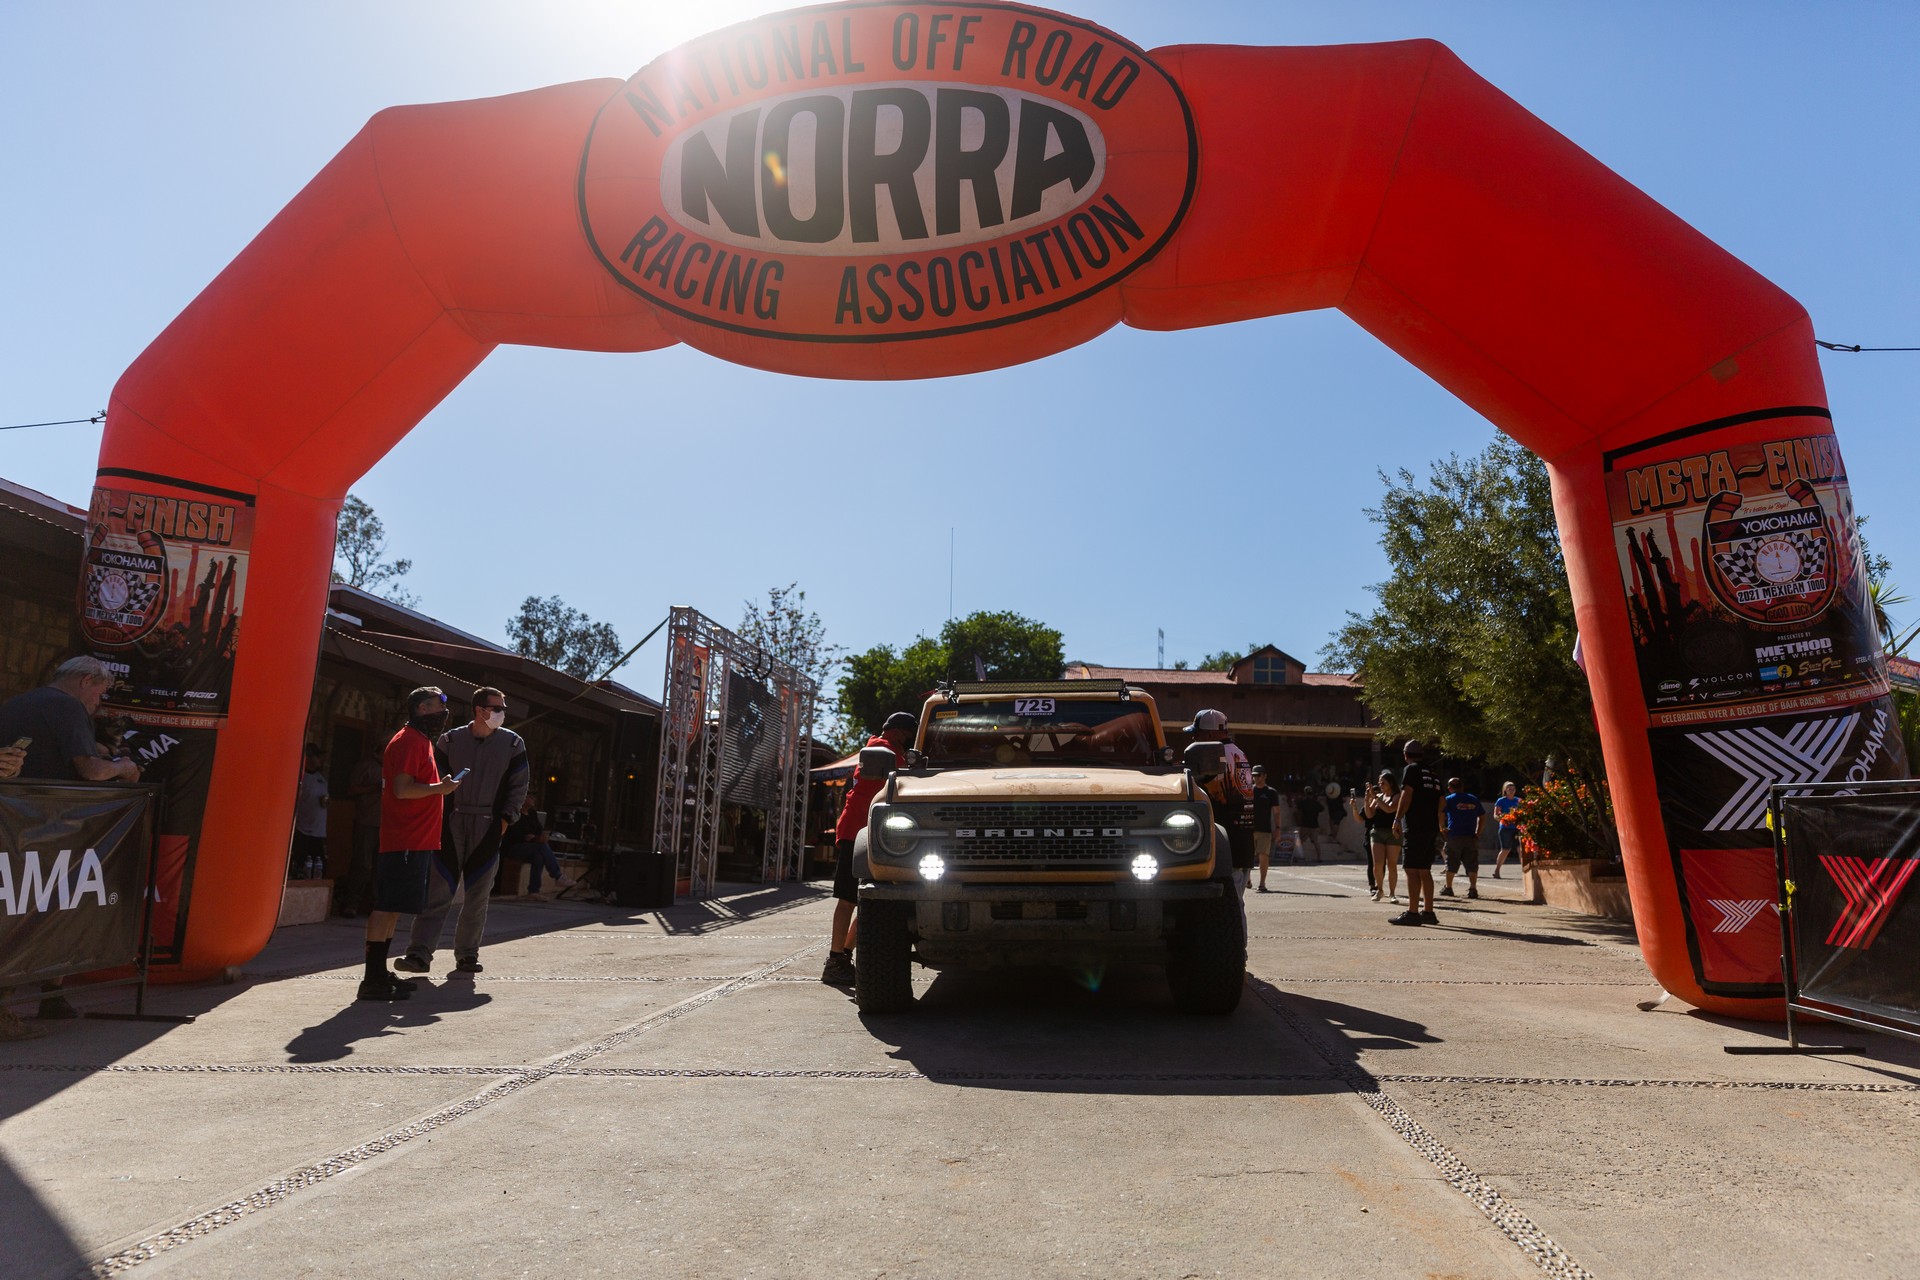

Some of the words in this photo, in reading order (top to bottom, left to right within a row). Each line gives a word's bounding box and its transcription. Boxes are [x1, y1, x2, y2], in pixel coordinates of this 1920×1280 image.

[624, 16, 866, 138] NATIONAL
[891, 13, 983, 72] OFF
[1001, 20, 1141, 111] ROAD
[680, 86, 1096, 244] NORRA
[620, 215, 786, 321] RACING
[834, 193, 1146, 325] ASSOCIATION
[1626, 451, 1739, 512] META
[127, 493, 235, 545] FINISH
[1741, 512, 1818, 534] YOKOHAMA
[1761, 542, 1790, 557] NORRA
[101, 552, 157, 571] YOKOHAMA
[1737, 591, 1760, 603] 2021
[1763, 583, 1806, 602] MEXICAN
[1808, 579, 1825, 592] 1000
[1768, 607, 1789, 620] GOOD
[1777, 632, 1804, 641] PRESENTED
[1755, 637, 1832, 658] METHOD
[1757, 654, 1786, 664] RACE
[1792, 647, 1833, 659] WHEELS
[1660, 681, 1681, 690] slime
[1702, 672, 1753, 684] VOLCON
[1017, 700, 1052, 711] 725
[1660, 711, 1707, 724] CELEBRATING
[1708, 709, 1728, 720] OVER
[1729, 708, 1735, 717] A
[1737, 704, 1767, 716] DECADE
[1768, 703, 1779, 712] OF
[1780, 699, 1799, 709] BAJA
[1800, 696, 1826, 707] RACING
[161, 716, 178, 725] RACE
[180, 718, 189, 726] ON
[1832, 708, 1888, 797] OHAMA
[956, 828, 1123, 838] BRONCO
